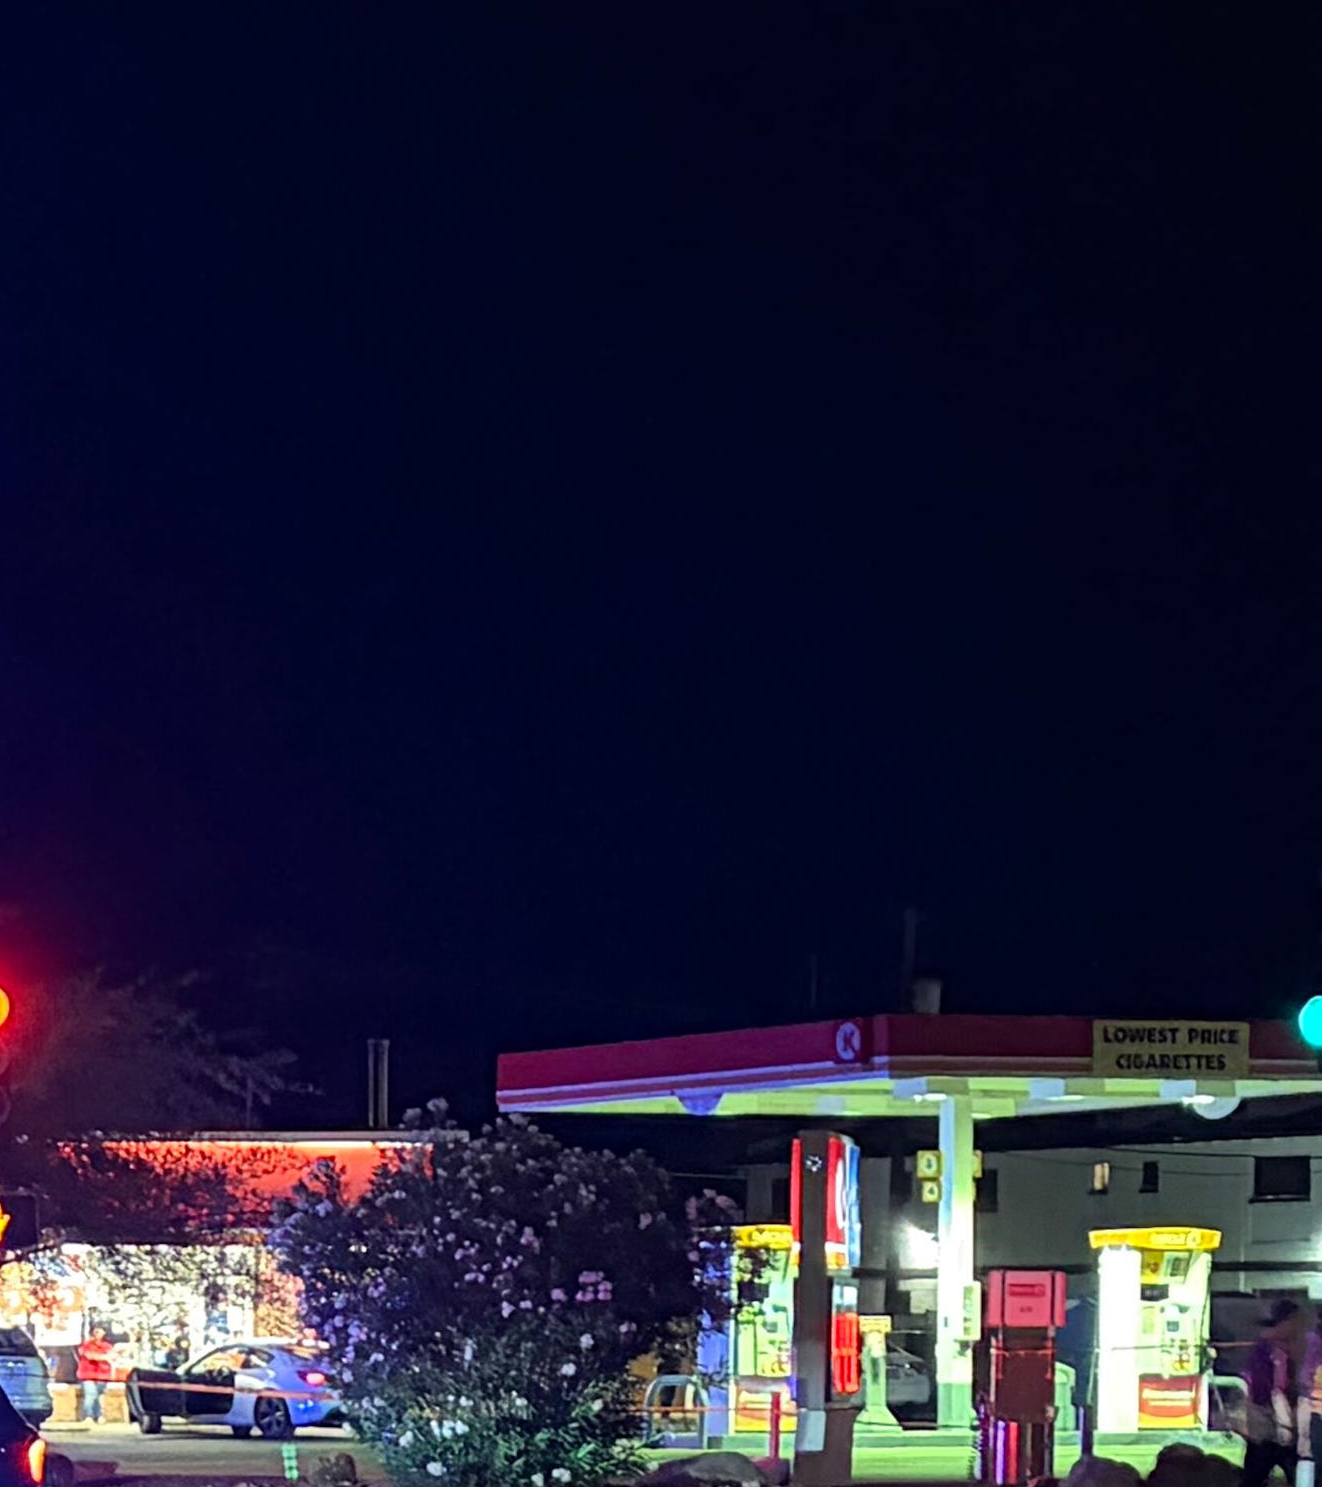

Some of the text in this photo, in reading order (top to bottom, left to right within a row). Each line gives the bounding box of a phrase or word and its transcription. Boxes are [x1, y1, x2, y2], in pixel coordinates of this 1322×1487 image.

[1103, 1026, 1239, 1045] LOWEST PRICE
[1115, 1053, 1227, 1071] CIGARETTES
